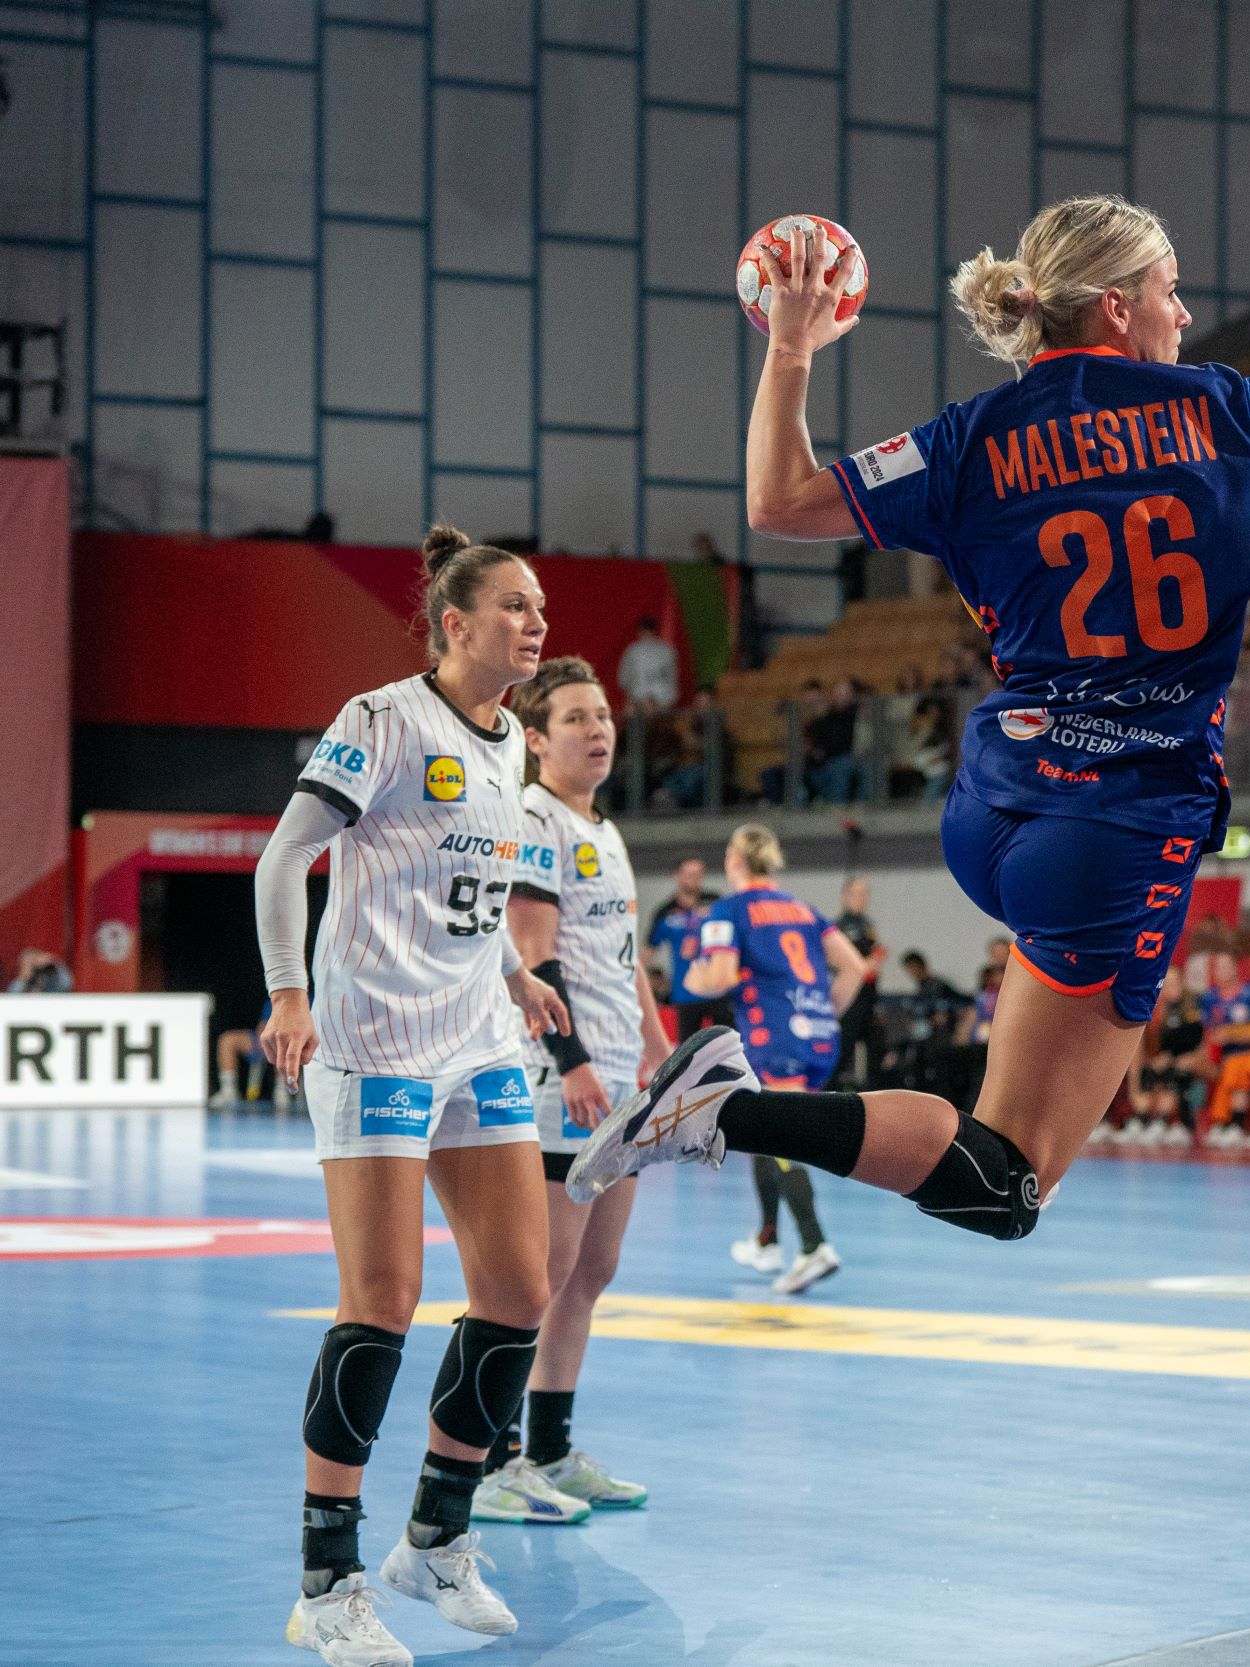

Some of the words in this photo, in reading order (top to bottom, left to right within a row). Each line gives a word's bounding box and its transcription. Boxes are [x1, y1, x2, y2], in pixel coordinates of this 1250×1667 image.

[985, 396, 1217, 500] MALESTEIN
[1037, 495, 1209, 659] 26
[314, 739, 367, 774] DKB
[1060, 713, 1184, 751] NEDERLANDSE
[517, 844, 555, 870] KB
[6, 1023, 162, 1083] RTH
